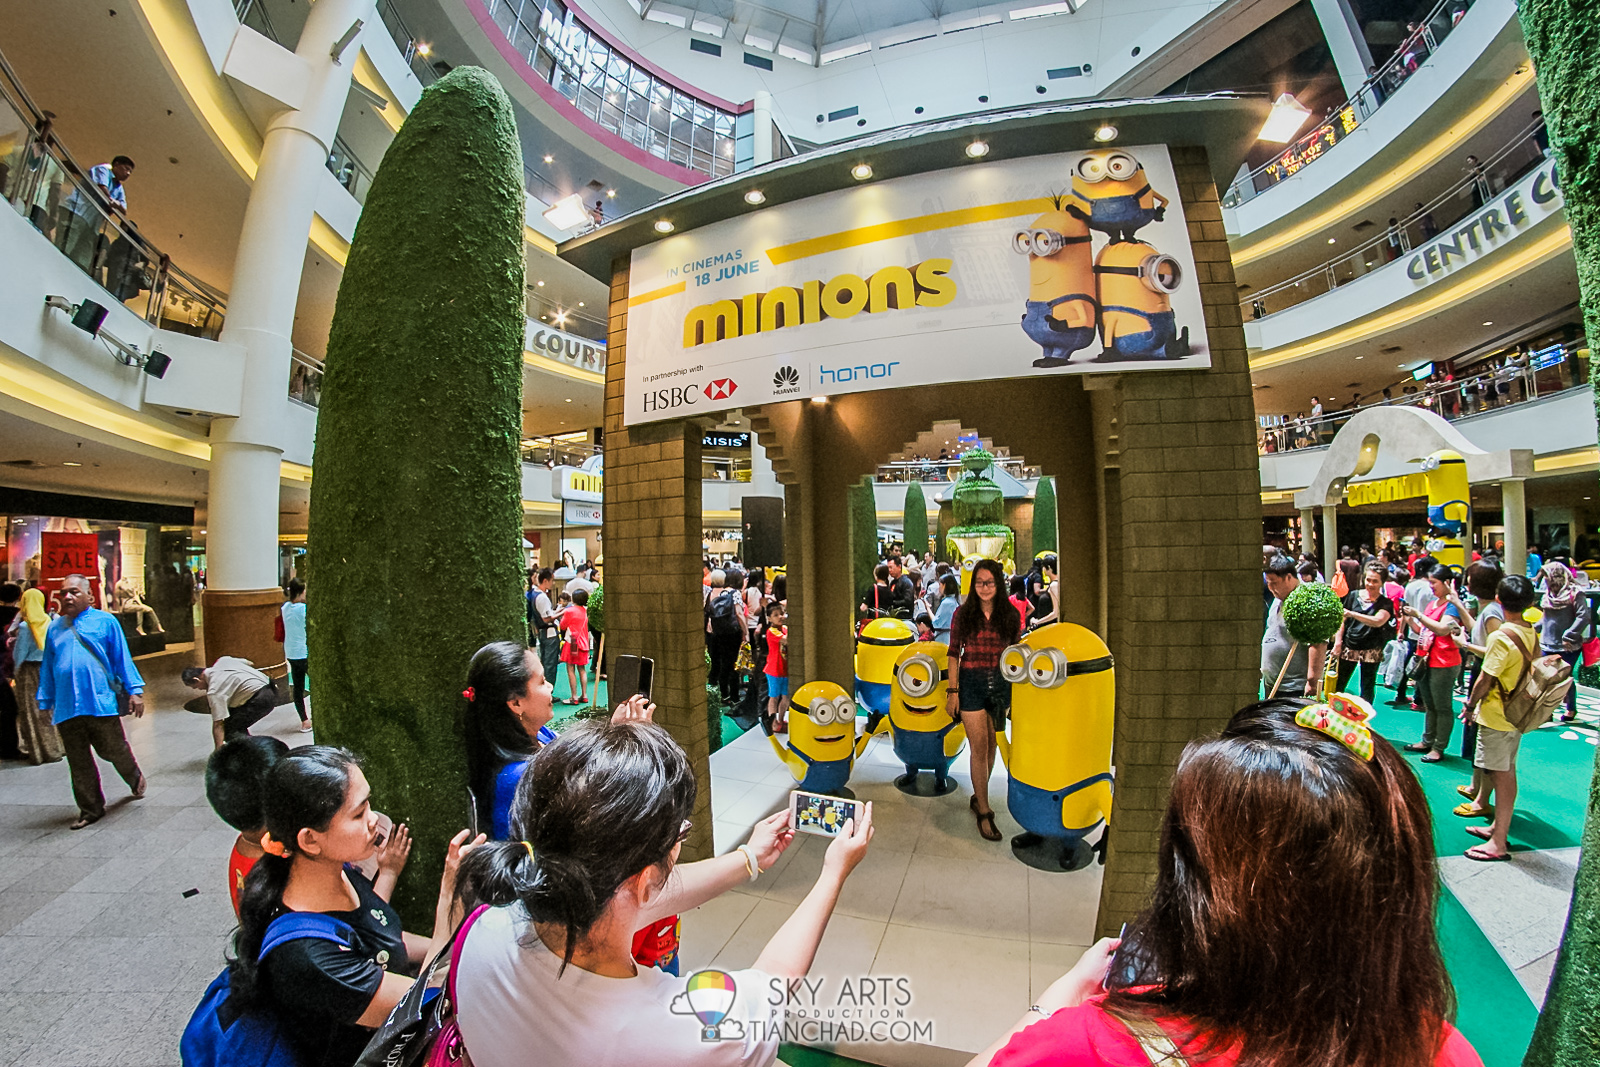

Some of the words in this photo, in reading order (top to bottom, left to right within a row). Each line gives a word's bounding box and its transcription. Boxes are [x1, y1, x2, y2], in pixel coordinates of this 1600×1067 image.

[1407, 190, 1529, 280] CENTRE
[666, 267, 679, 279] IN
[682, 249, 743, 274] CINEMAS
[694, 272, 711, 287] 18
[715, 260, 760, 282] JUNE
[533, 330, 606, 367] COURT
[643, 375, 651, 383] In
[650, 368, 688, 383] partnership
[689, 364, 704, 374] with
[820, 361, 900, 385] honor
[642, 384, 699, 413] HSBC
[772, 386, 801, 396] HUAWEI
[575, 509, 592, 519] HSBC
[47, 550, 94, 569] SALE
